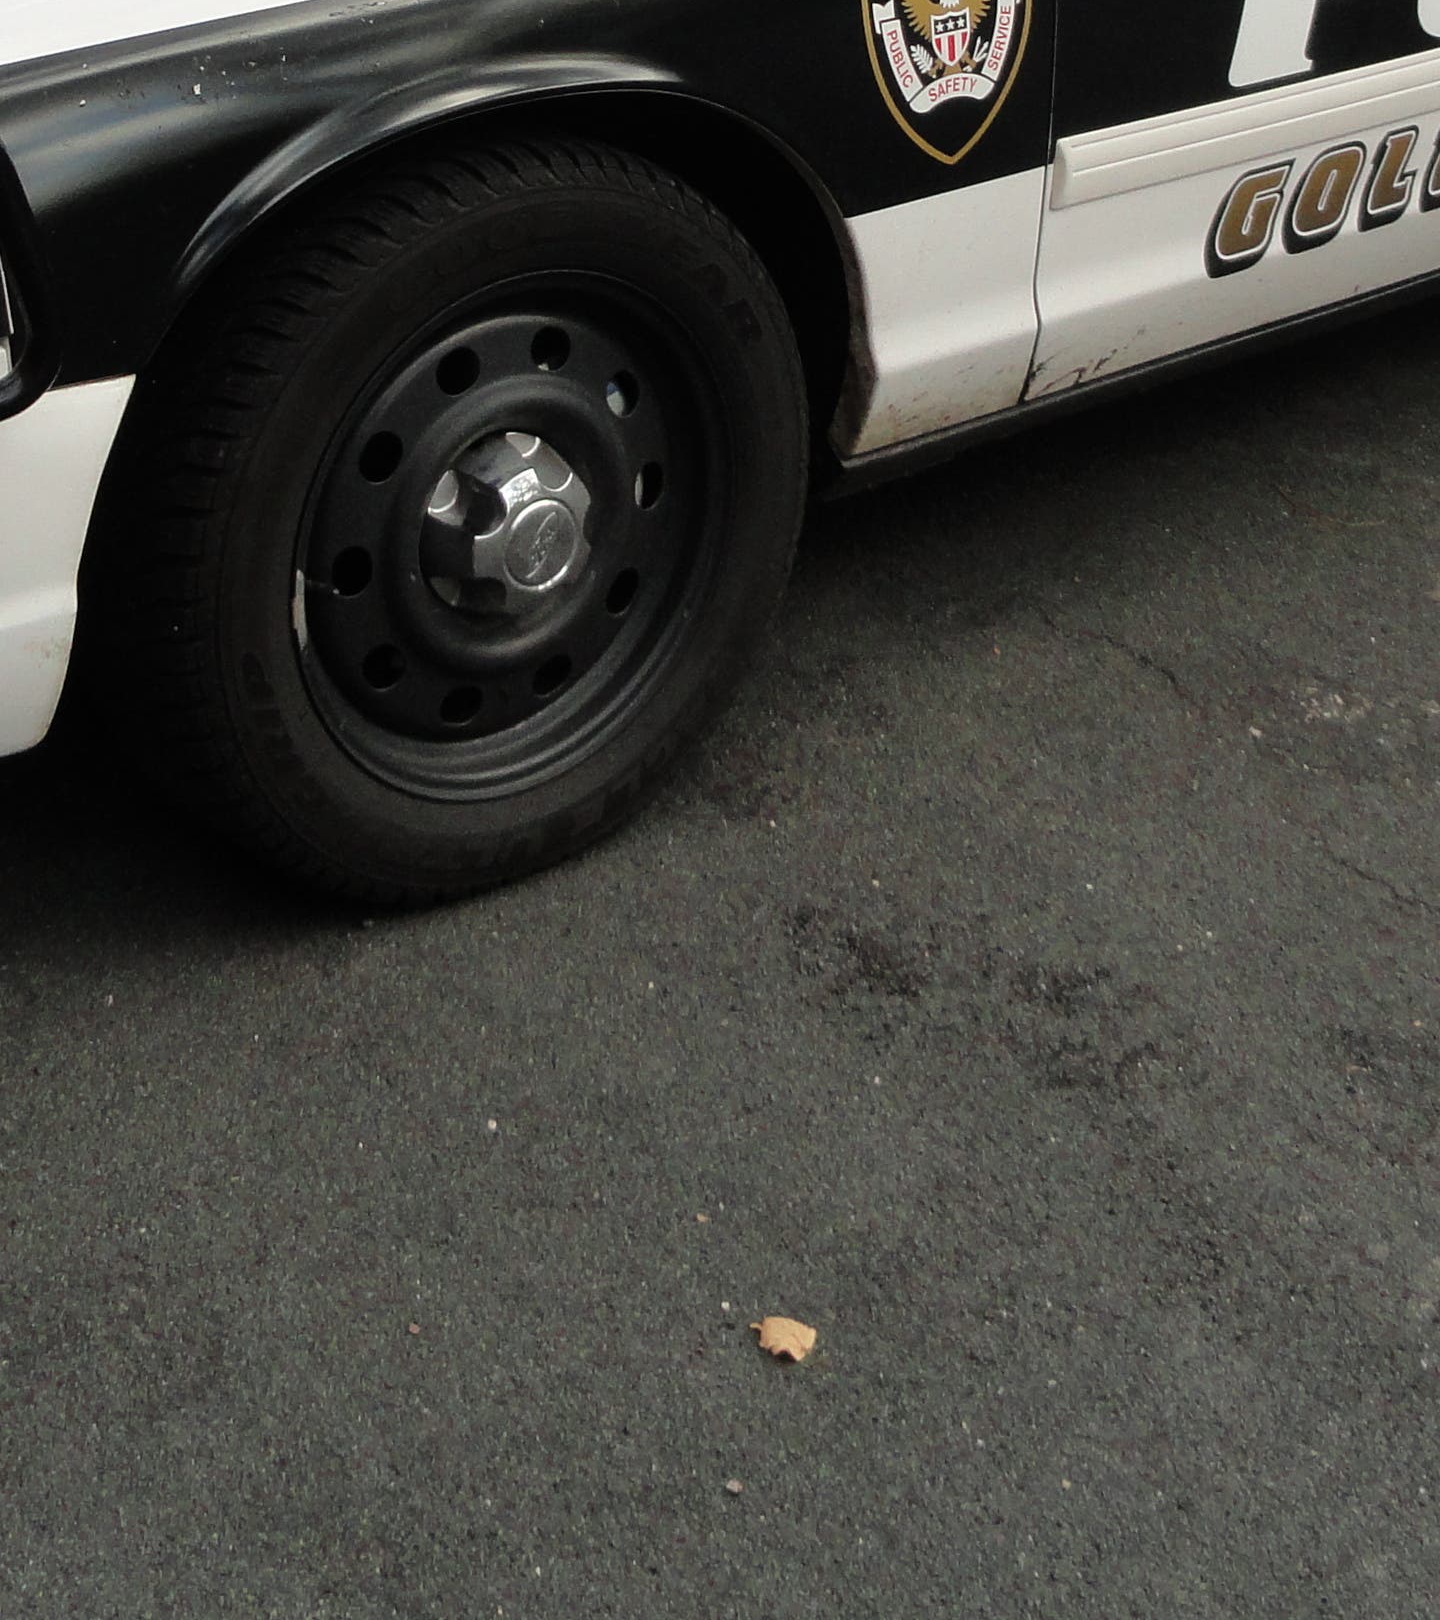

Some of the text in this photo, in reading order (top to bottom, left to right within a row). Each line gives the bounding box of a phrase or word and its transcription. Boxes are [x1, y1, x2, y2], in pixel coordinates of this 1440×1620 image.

[886, 29, 914, 89] PUBLIC
[986, 4, 1012, 72] SERVICE
[927, 75, 978, 102] SAFETY
